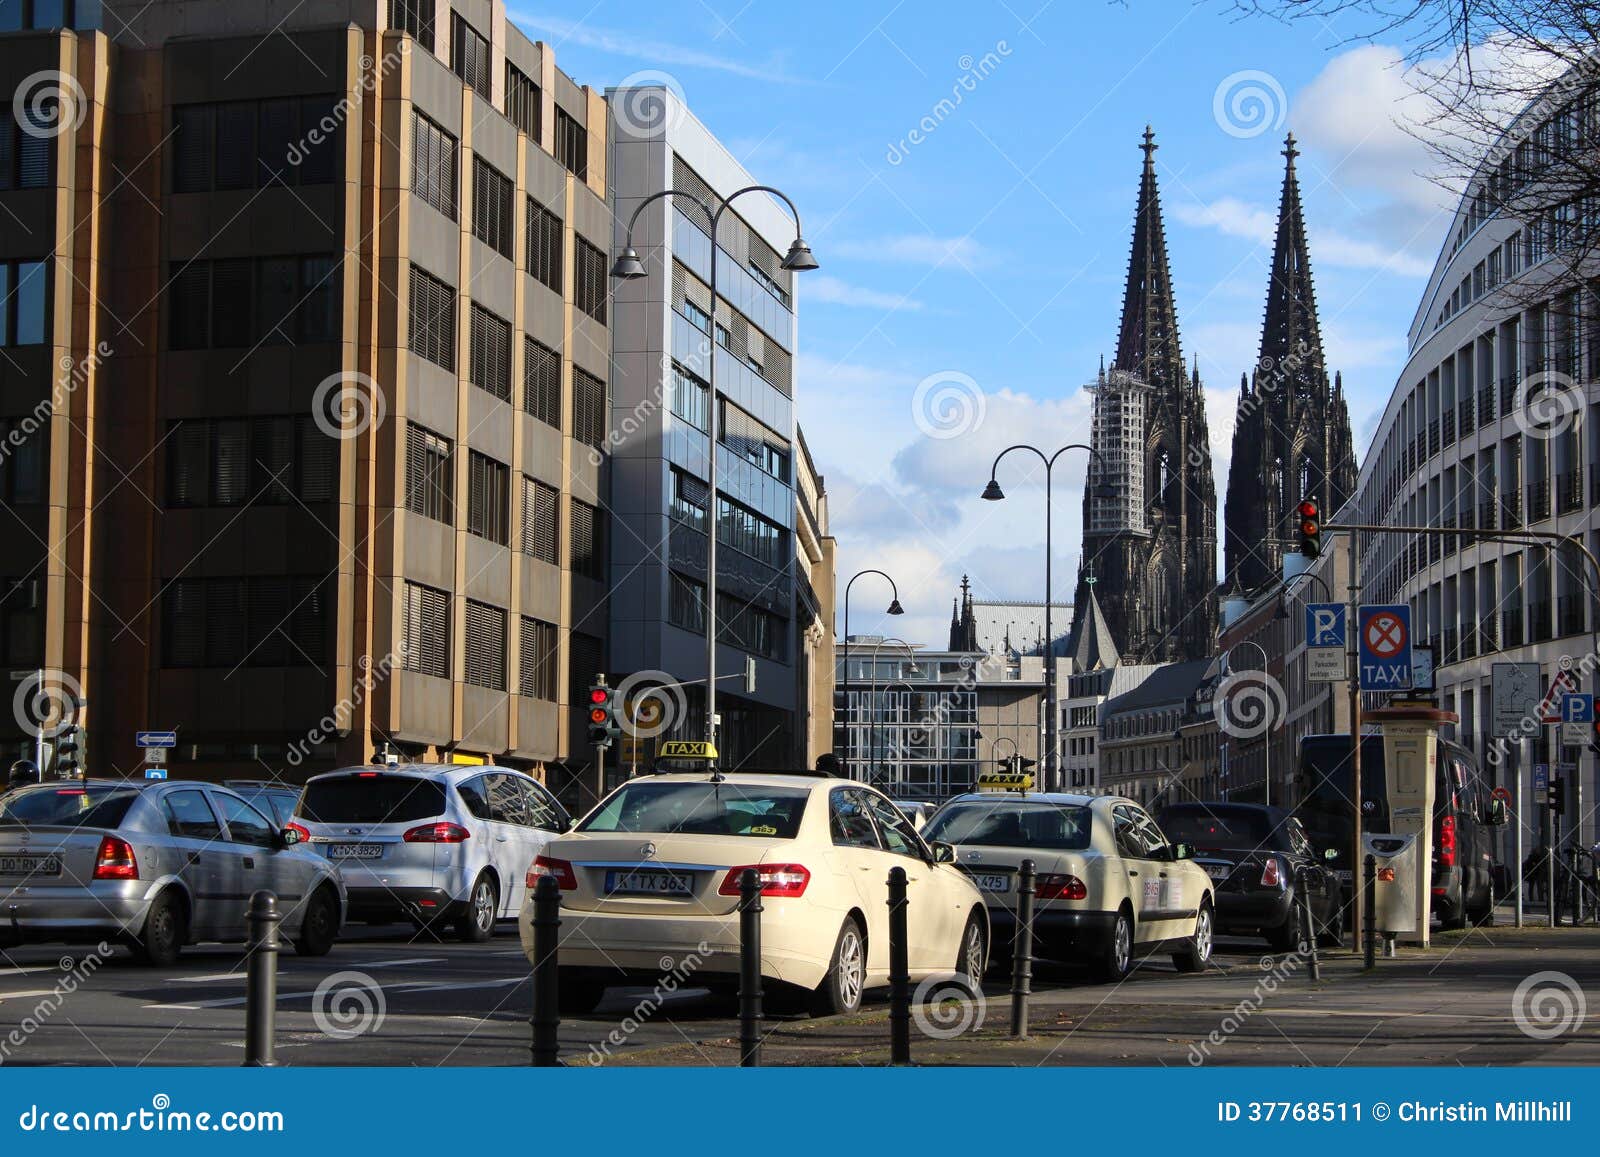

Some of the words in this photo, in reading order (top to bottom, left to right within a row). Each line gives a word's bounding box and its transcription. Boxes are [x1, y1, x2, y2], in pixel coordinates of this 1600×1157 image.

[1315, 609, 1337, 645] P
[1363, 664, 1408, 684] TAXI
[1569, 698, 1586, 722] P
[668, 743, 706, 755] TAXI
[985, 774, 1020, 783] TAXI
[639, 875, 656, 889] TX
[660, 875, 688, 890] 363
